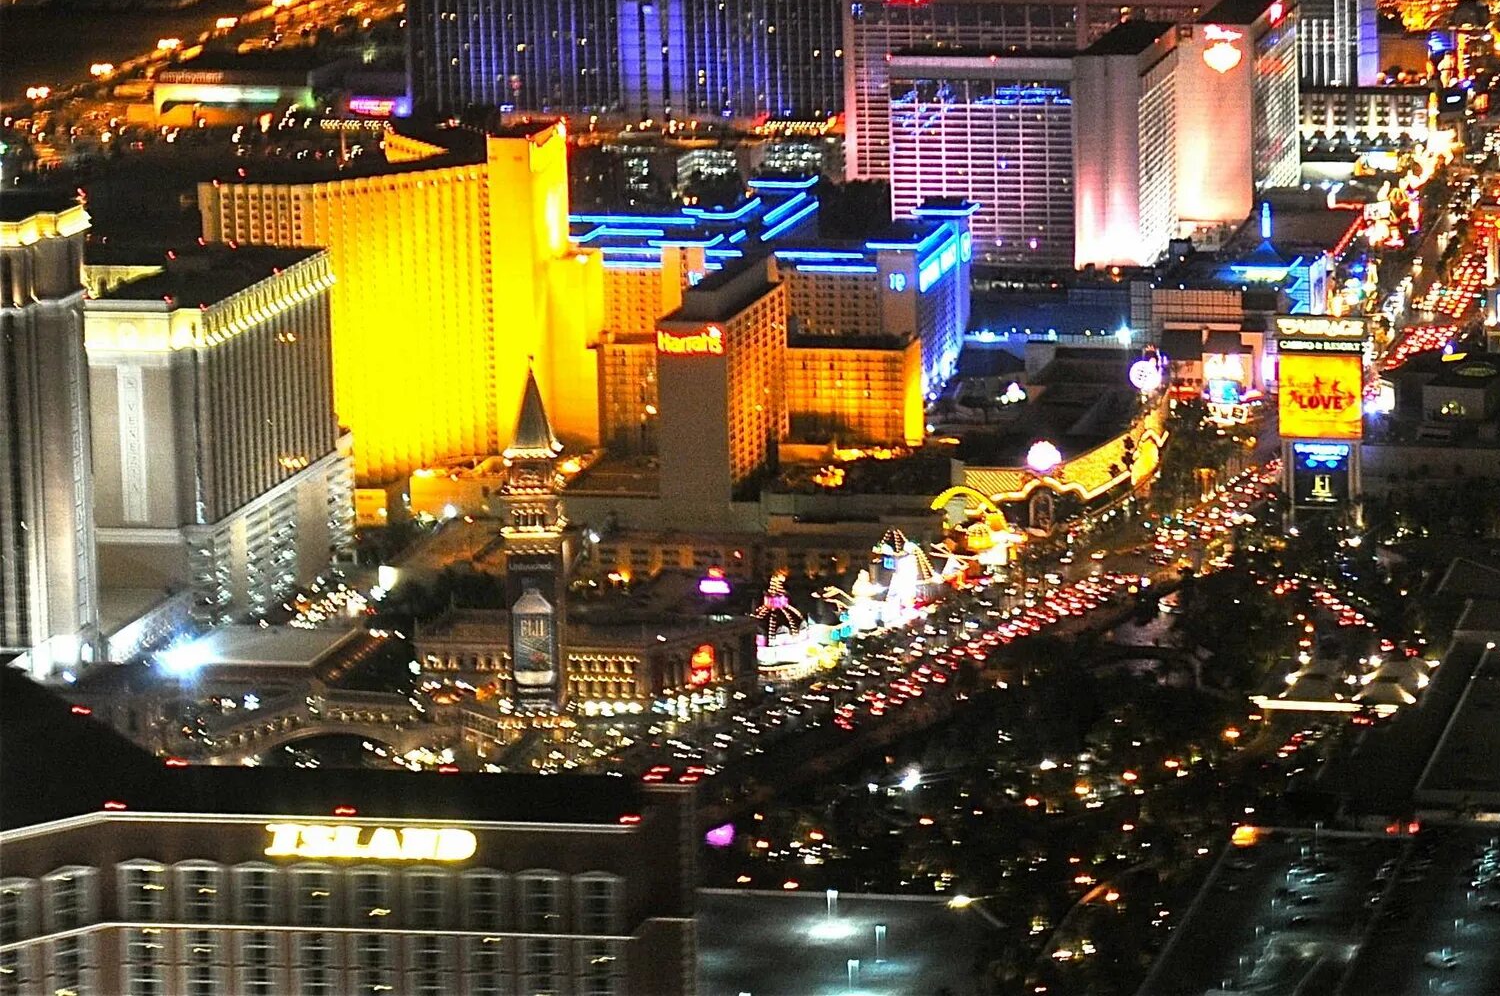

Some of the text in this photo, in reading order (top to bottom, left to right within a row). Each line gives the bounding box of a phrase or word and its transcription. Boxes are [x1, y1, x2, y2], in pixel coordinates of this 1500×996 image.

[1299, 395, 1343, 410] LOVE
[520, 619, 544, 637] FIJI
[264, 823, 477, 861] ISLAND
